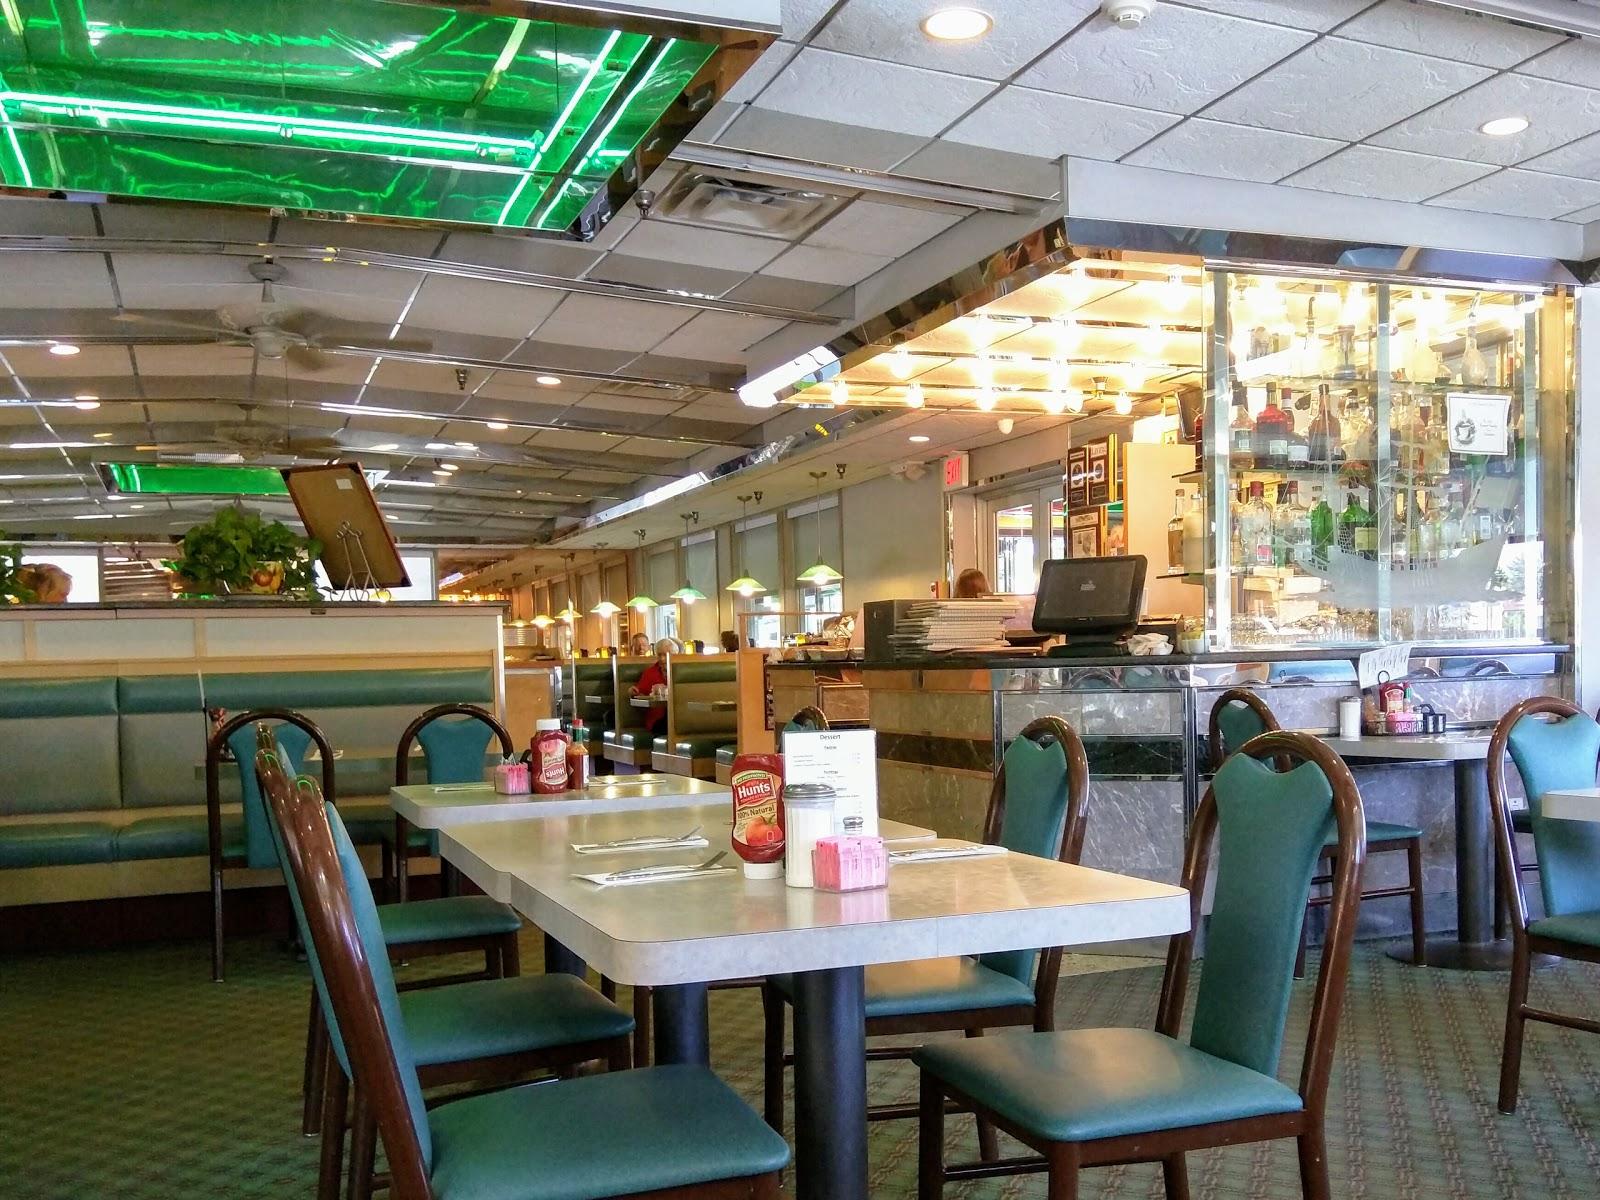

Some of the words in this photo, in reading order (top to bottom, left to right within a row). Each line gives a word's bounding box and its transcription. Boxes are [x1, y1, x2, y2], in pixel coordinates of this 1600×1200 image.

[945, 456, 961, 485] EXIT
[737, 782, 771, 799] Hunt's
[750, 804, 775, 816] Natural
